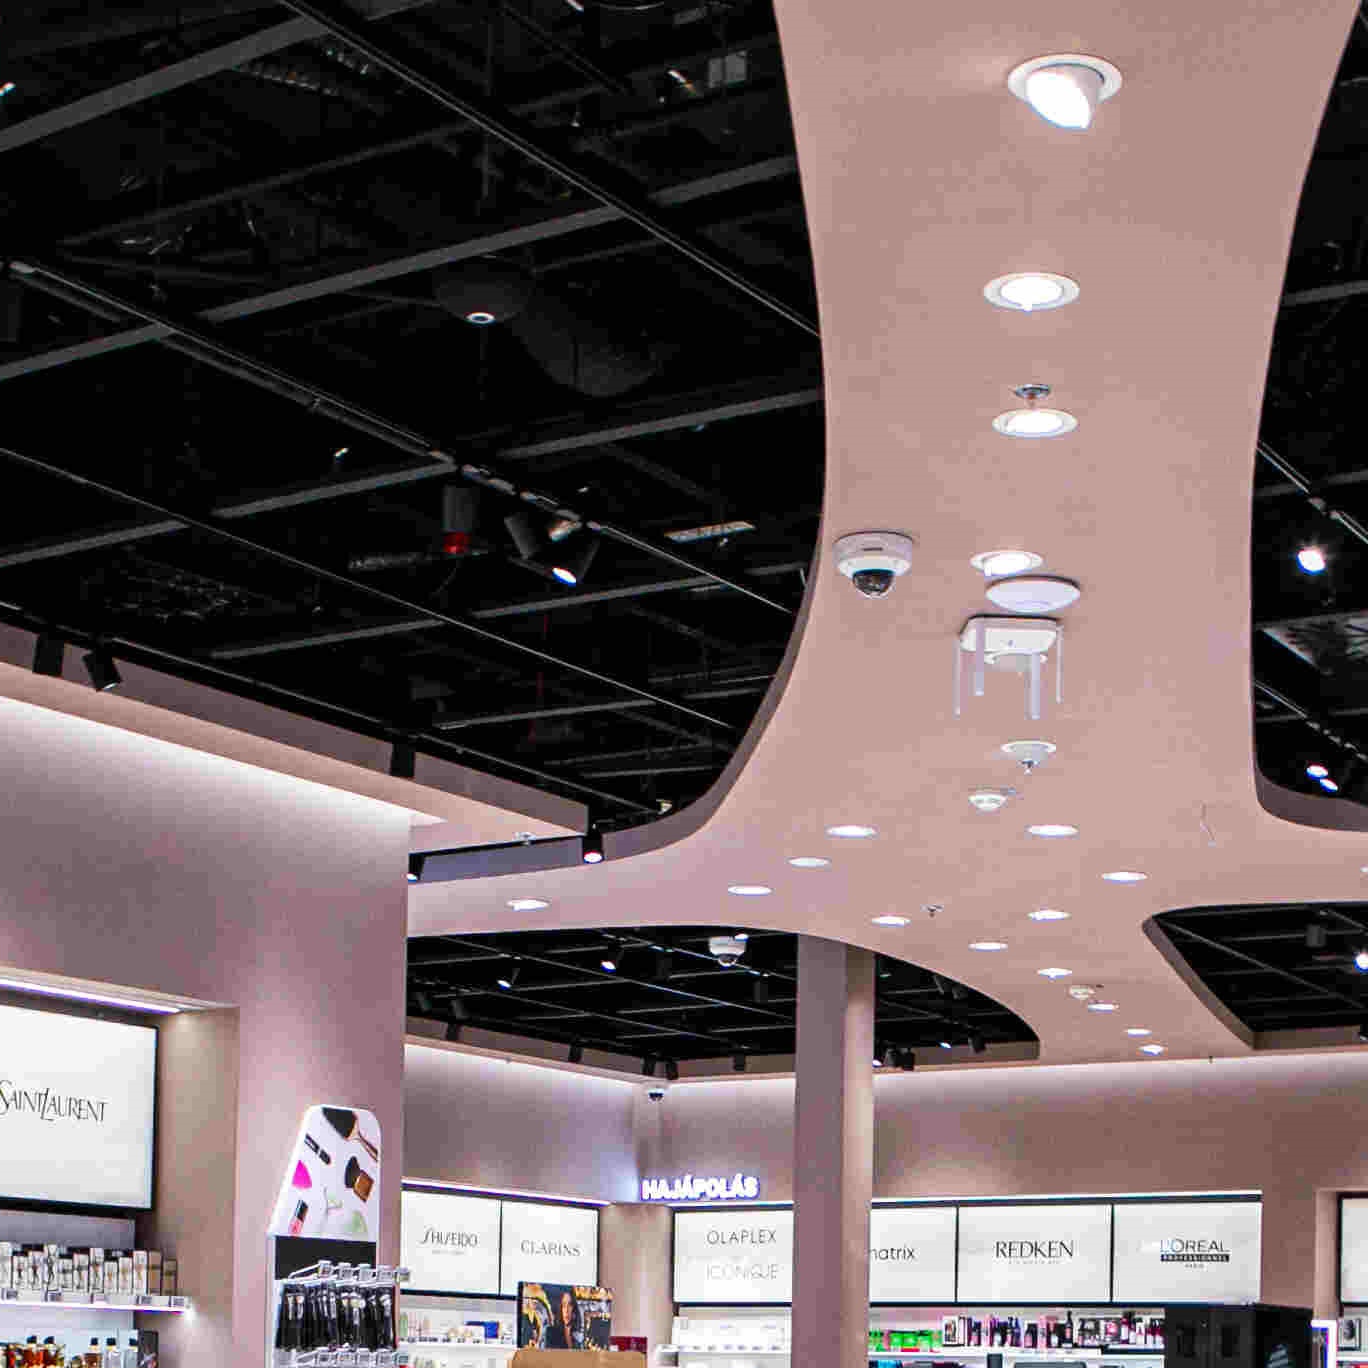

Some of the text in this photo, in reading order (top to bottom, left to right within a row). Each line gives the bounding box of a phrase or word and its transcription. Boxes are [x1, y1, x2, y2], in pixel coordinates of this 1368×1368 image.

[641, 1172, 761, 1200] HAJÁPOLÁS
[706, 1228, 778, 1245] OLAPLEX
[520, 1239, 583, 1257] CLARINS
[994, 1240, 1074, 1259] REDKEN
